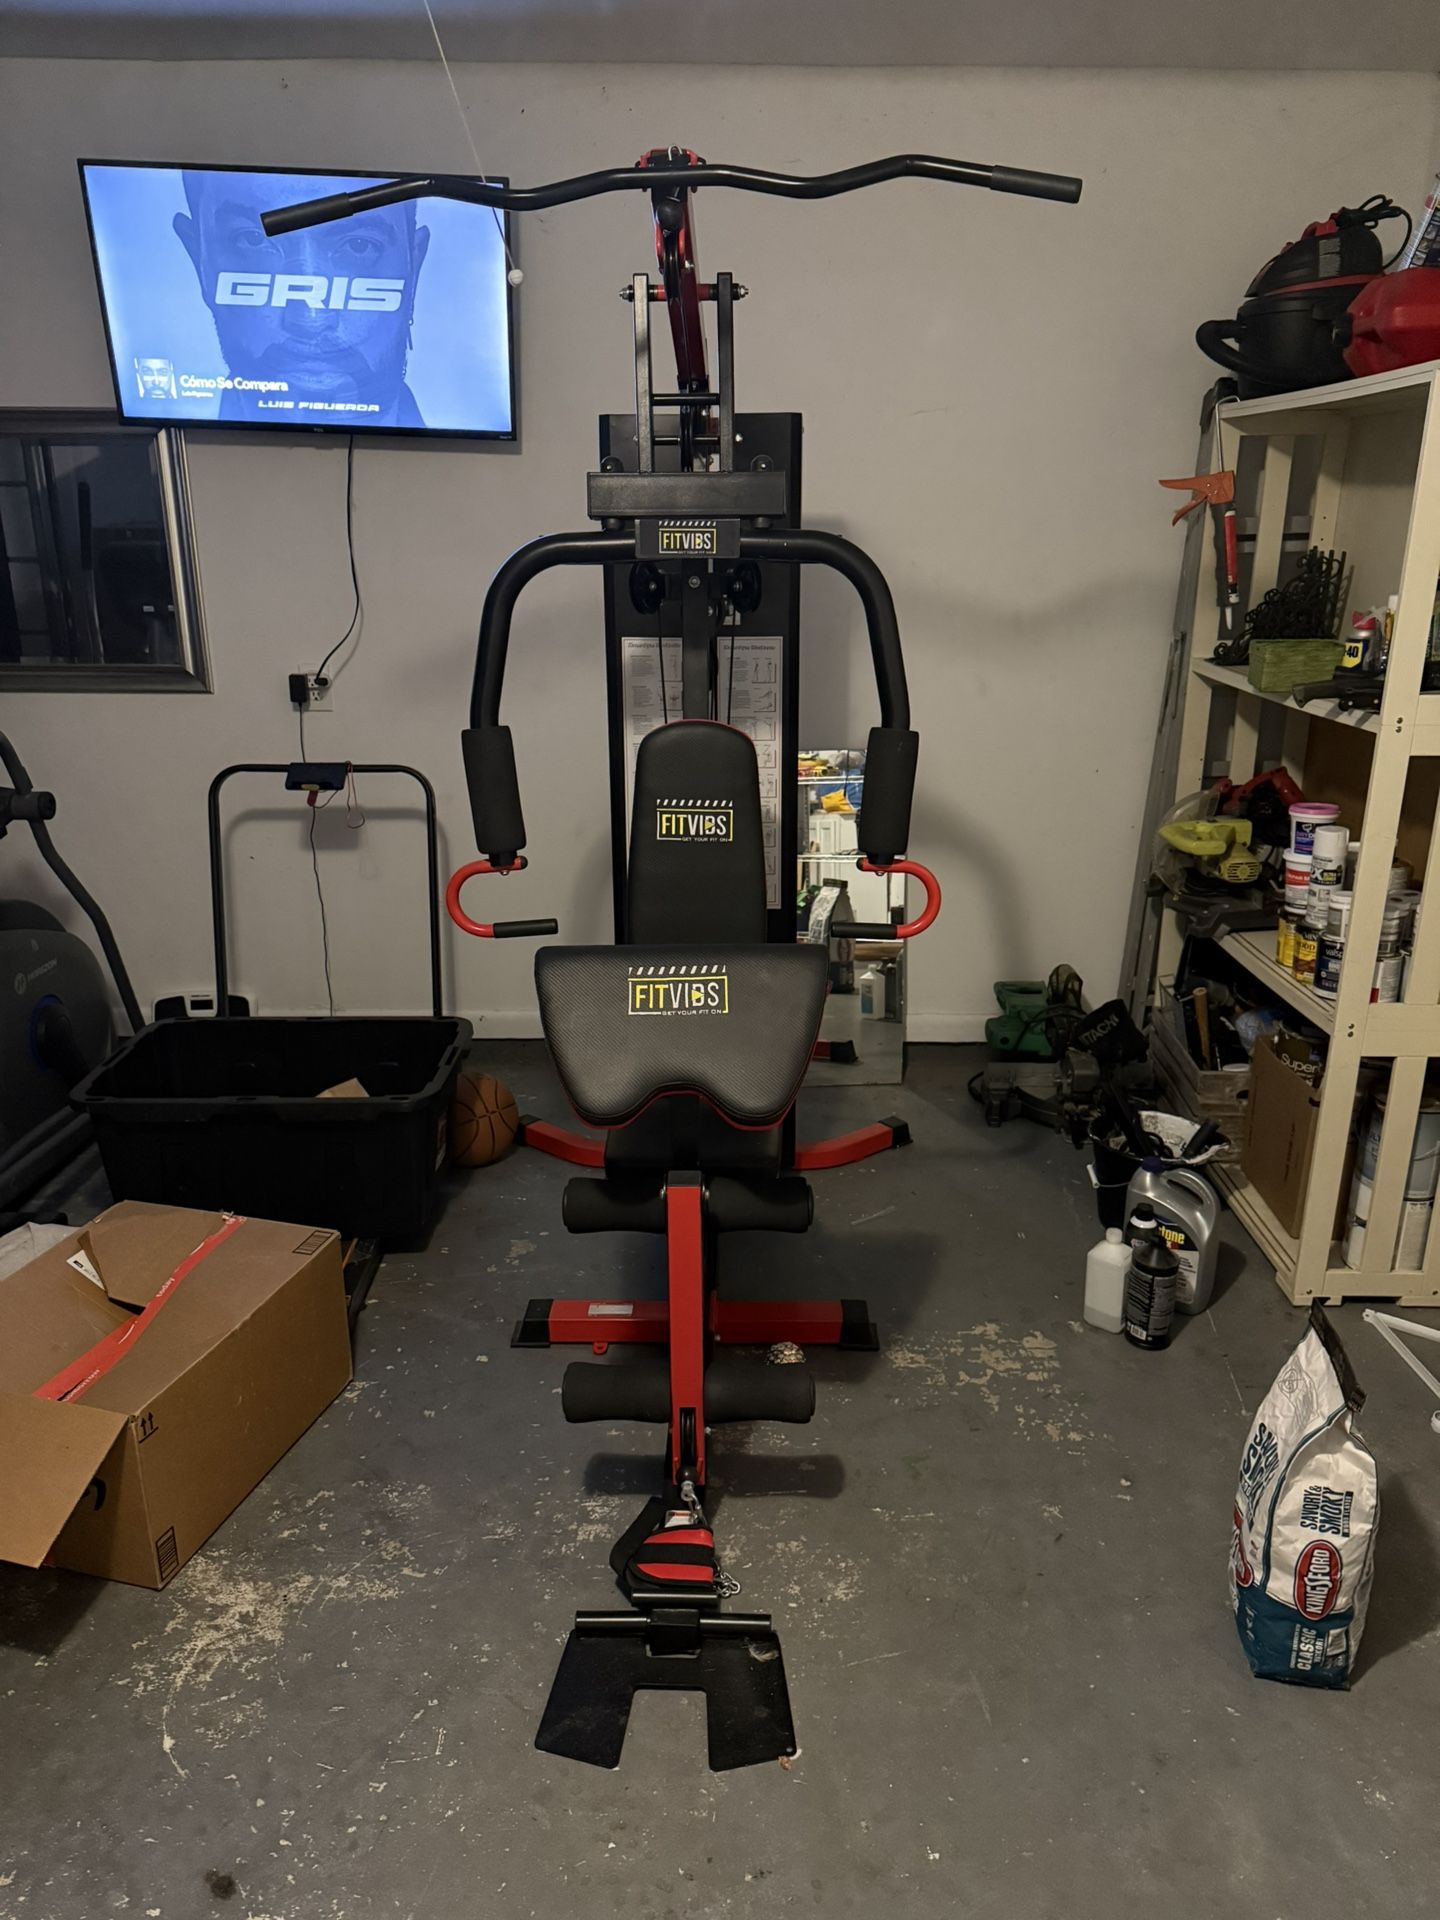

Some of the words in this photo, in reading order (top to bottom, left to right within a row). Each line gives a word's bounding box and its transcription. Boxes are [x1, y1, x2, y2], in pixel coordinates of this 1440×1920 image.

[214, 271, 405, 312] GRIS
[180, 374, 216, 389] Cómo
[216, 376, 234, 389] Se
[234, 377, 289, 393] Compara
[258, 400, 295, 409] LUIS
[1300, 1489, 1321, 1530] SAVORY
[1319, 1487, 1344, 1535] SMOKY
[1304, 1549, 1333, 1614] KINGSFORD
[1297, 1627, 1317, 1670] CLASSIC
